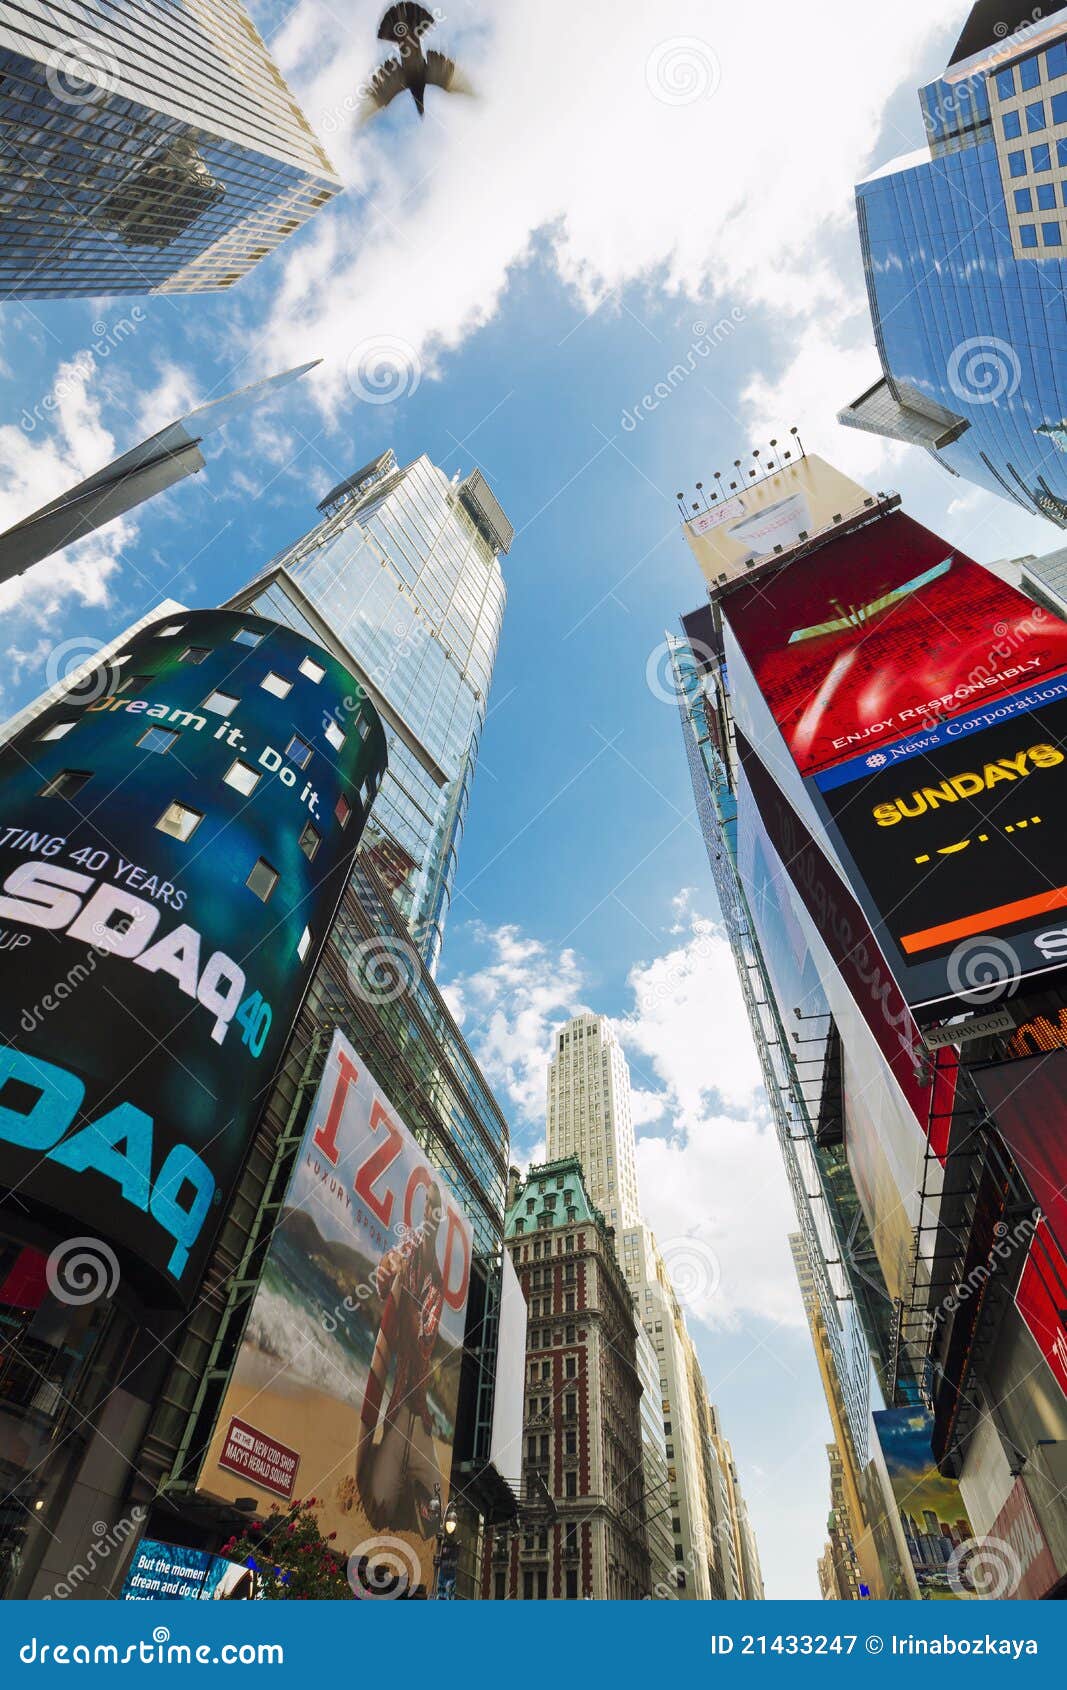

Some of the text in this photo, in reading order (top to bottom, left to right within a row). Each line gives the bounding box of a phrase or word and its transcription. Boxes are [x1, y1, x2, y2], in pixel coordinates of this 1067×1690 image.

[832, 657, 1042, 750] ENJOY RESPONSIBLY
[890, 684, 1067, 760] News Corporation
[86, 697, 320, 820] Dream it. Do it.
[872, 743, 1065, 827] SUNDAYS
[0, 827, 188, 911] TING 40 YEARS
[0, 930, 32, 951] UP
[928, 1015, 1011, 1045] SHERWOOD
[0, 1044, 216, 1281] DAQ
[306, 1151, 352, 1208] LUXURY
[225, 1443, 292, 1489] MACY'S HERALD SQUARE
[253, 1440, 269, 1458] NEW
[280, 1454, 296, 1473] SHOP
[131, 1573, 161, 1591] dream
[161, 1580, 180, 1595] and
[179, 1582, 191, 1596] do
[138, 1555, 154, 1571] But
[155, 1559, 170, 1574] the
